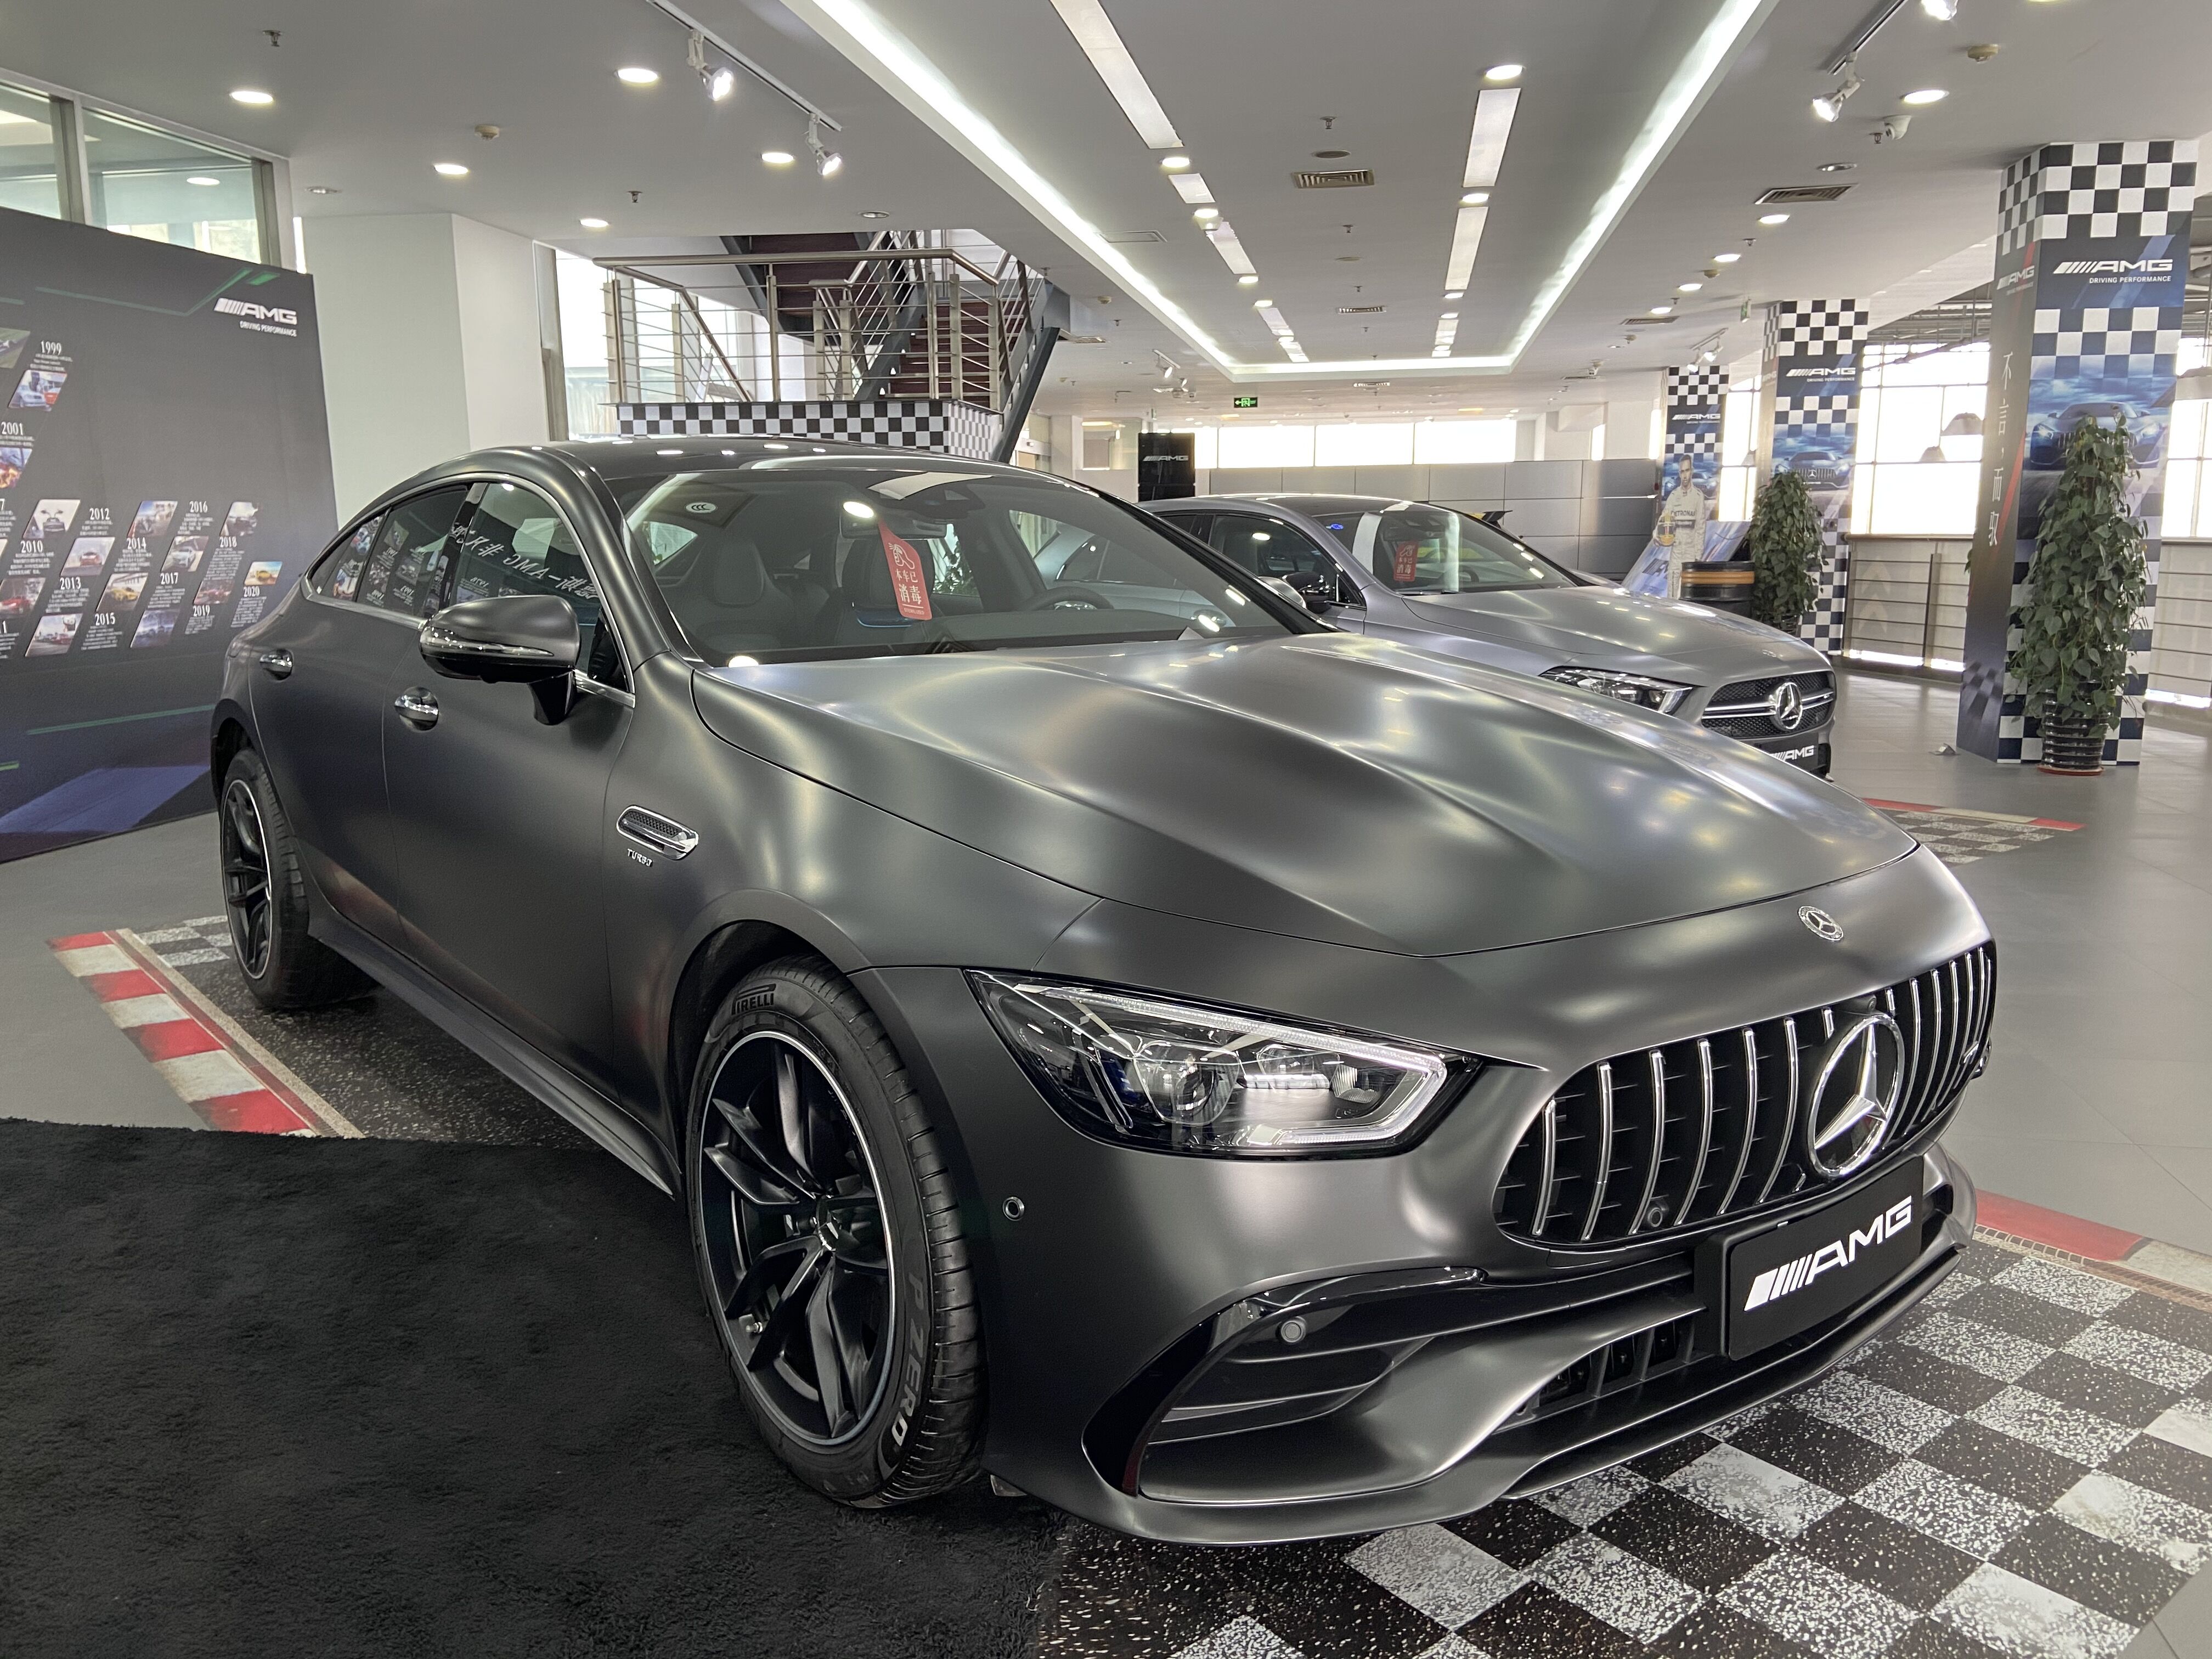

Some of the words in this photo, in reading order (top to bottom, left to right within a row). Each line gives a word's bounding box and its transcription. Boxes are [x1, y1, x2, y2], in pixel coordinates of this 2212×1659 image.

[2090, 259, 2173, 273] AMG
[2008, 265, 2035, 285] AMG
[240, 302, 297, 325] AMG
[41, 340, 62, 356] 1999
[1808, 367, 1856, 376] AMG
[1, 421, 24, 436] 2001
[89, 507, 110, 521] 2012
[189, 501, 207, 514] 2016
[20, 540, 43, 554] 2010
[127, 538, 146, 550] 2014
[219, 536, 236, 548] 2018
[160, 572, 178, 585] 2017
[895, 568, 918, 583] 本车已
[60, 577, 81, 590] 2013
[244, 586, 260, 597] 2020
[899, 583, 922, 605] 消毒
[193, 605, 210, 617] 2019
[95, 613, 115, 626] 2015
[1783, 745, 1814, 761] AMG
[627, 848, 653, 867] TURBO
[731, 983, 776, 1015] PIRELLI
[1804, 1195, 1912, 1286] AMG
[908, 1273, 924, 1311] P
[891, 1318, 925, 1447] ZERO
